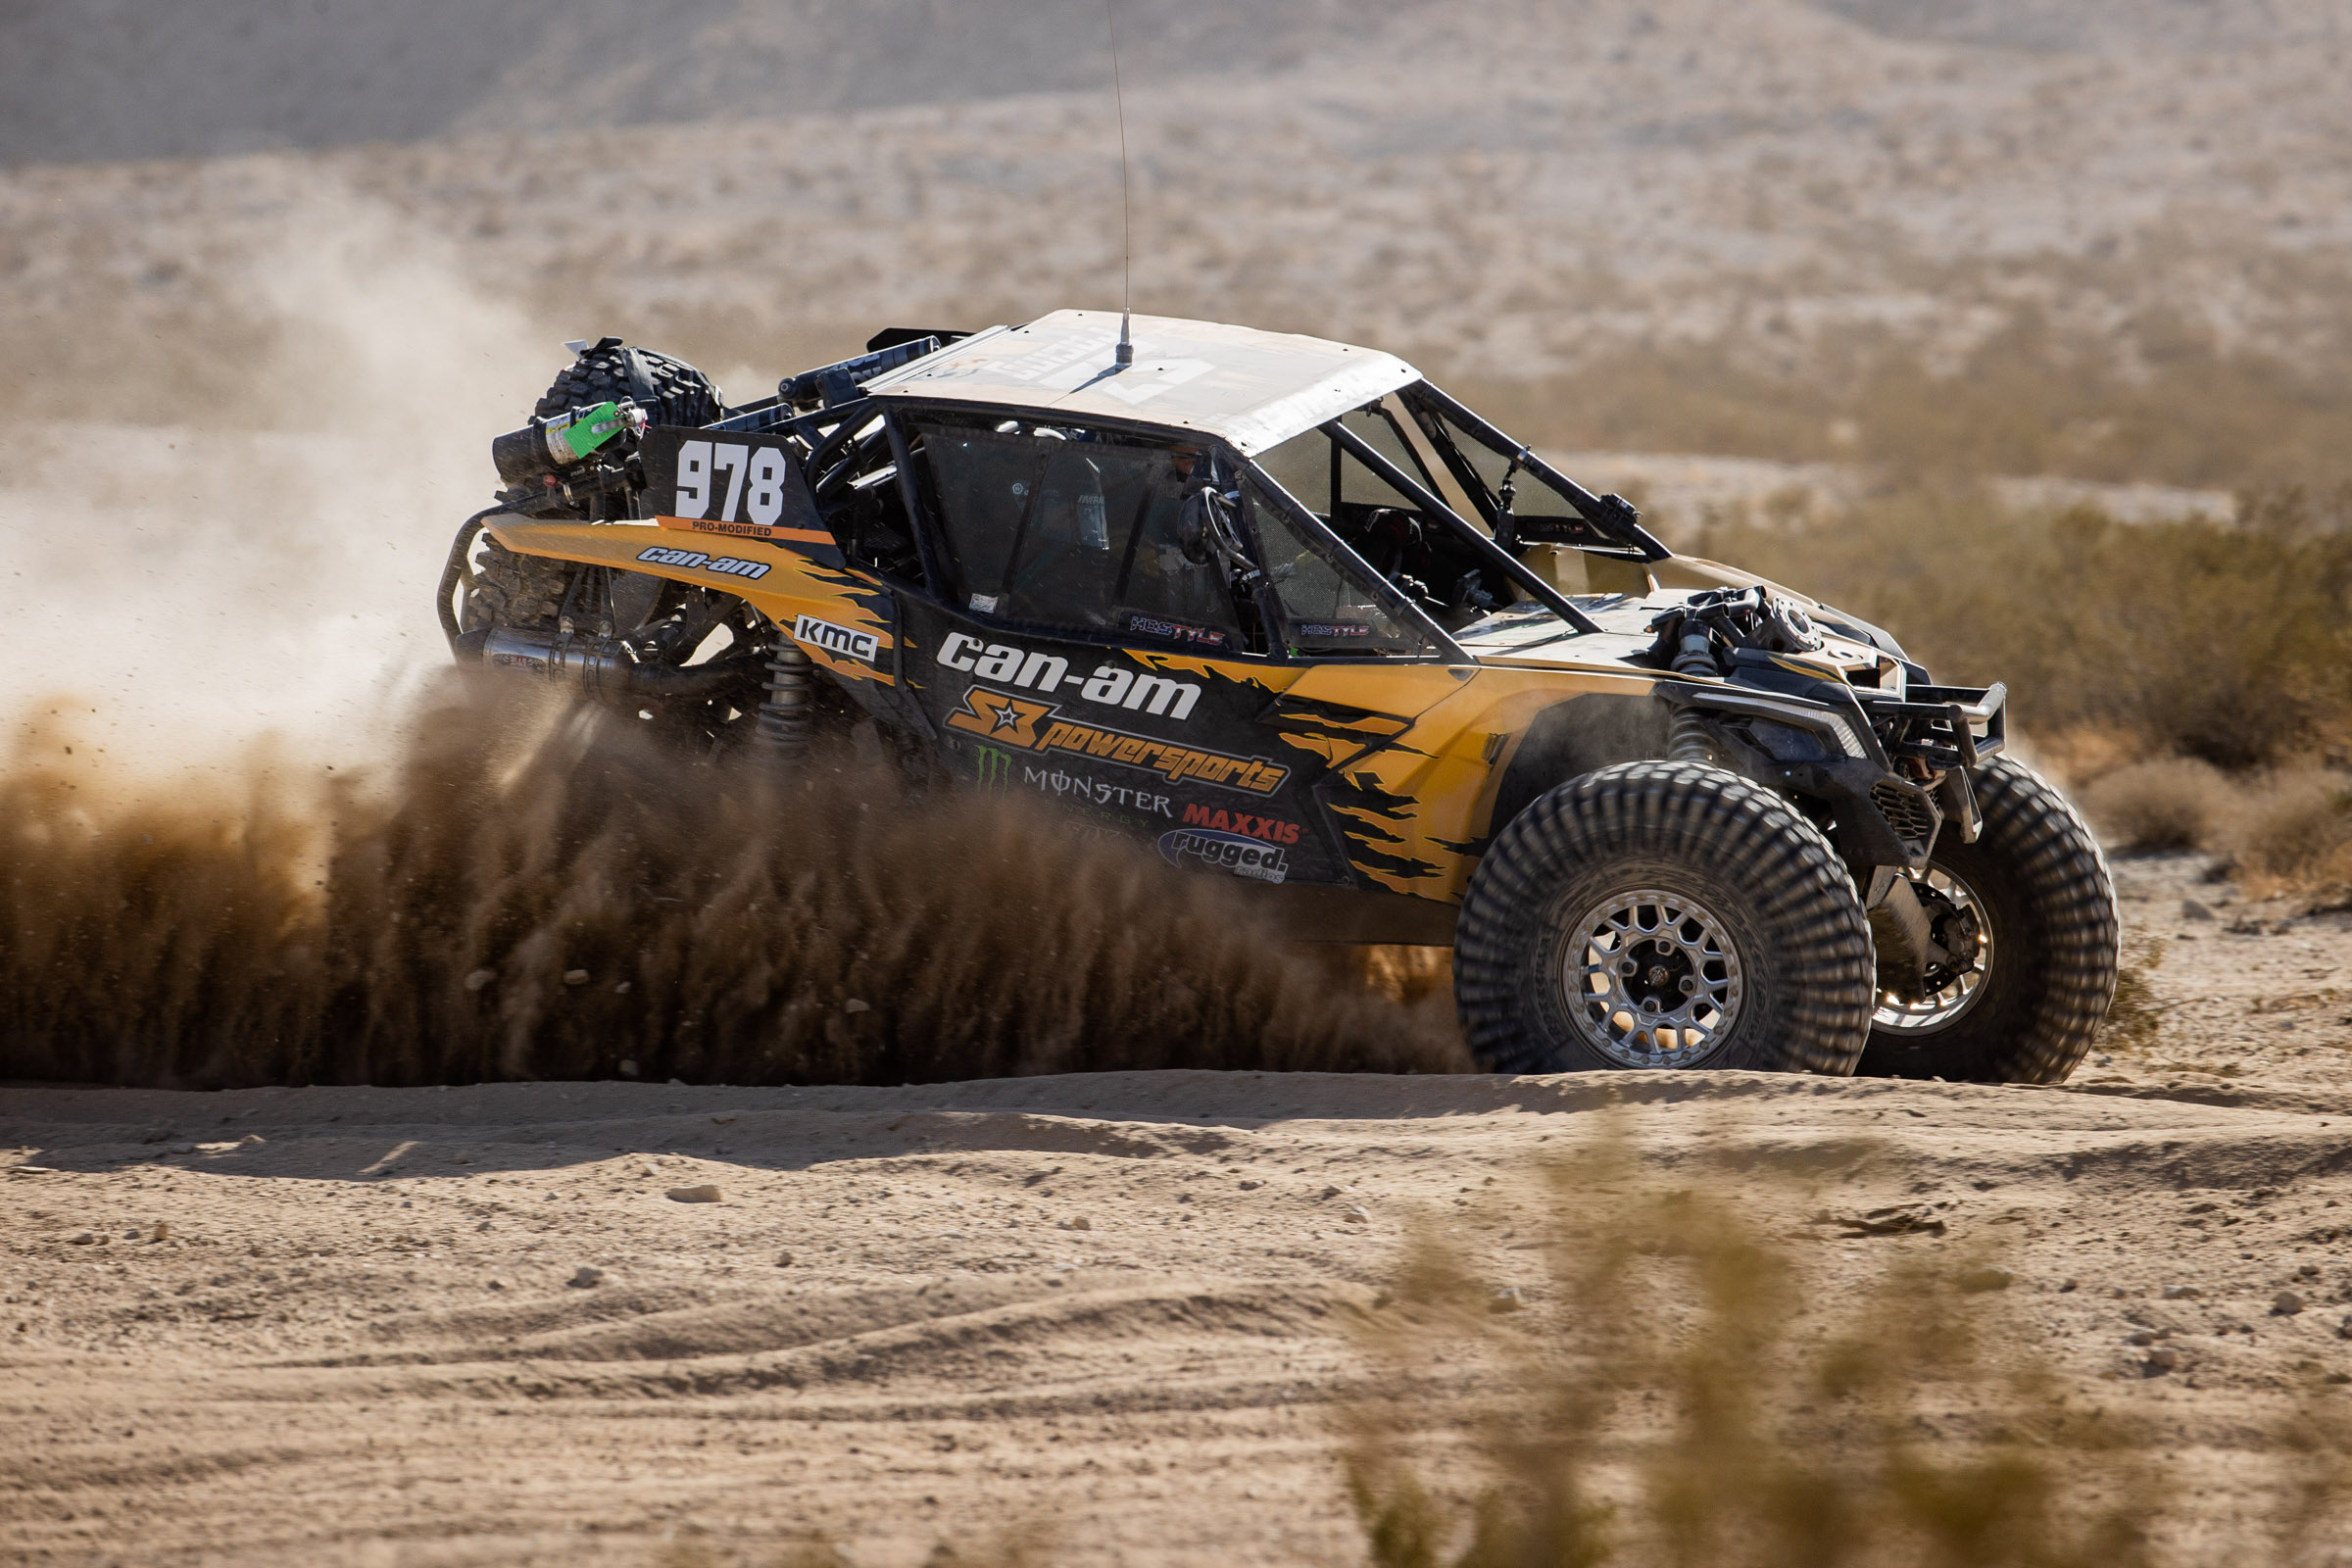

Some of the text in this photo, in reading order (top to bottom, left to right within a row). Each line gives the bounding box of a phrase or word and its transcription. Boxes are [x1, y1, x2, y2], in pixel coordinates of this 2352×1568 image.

[674, 439, 787, 526] 978
[692, 520, 772, 537] PRO-MODIFIED
[637, 546, 771, 580] can-am
[936, 630, 1202, 720] can-am
[1034, 719, 1288, 792] powersports
[1044, 799, 1152, 828] ENERGY
[1181, 802, 1301, 845] MAXXIS
